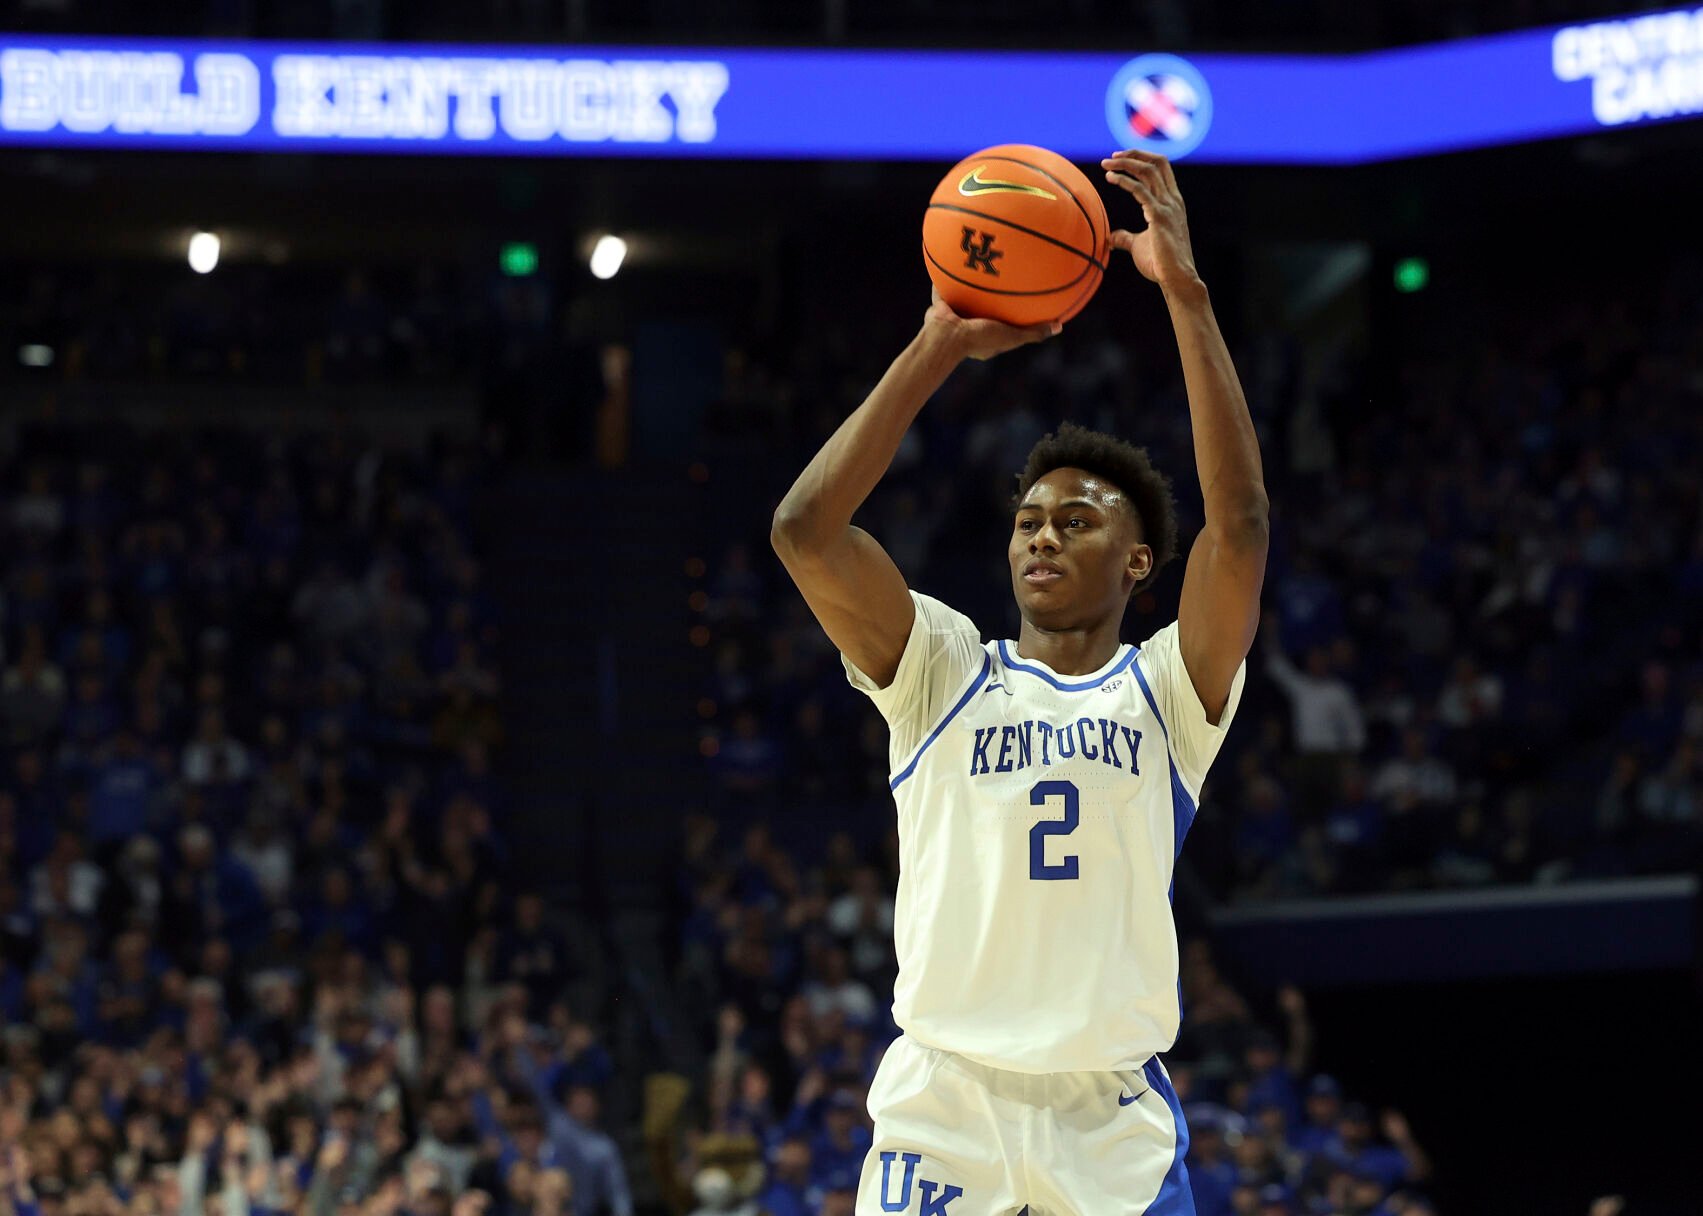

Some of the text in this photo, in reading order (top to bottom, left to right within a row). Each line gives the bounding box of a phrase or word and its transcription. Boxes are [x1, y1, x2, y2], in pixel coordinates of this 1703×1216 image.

[0, 48, 729, 144] BUILD KENTUCKY
[961, 225, 1004, 277] UK
[970, 717, 1143, 776] KENTUCKY
[1029, 780, 1080, 880] 2
[880, 1151, 963, 1216] UK
